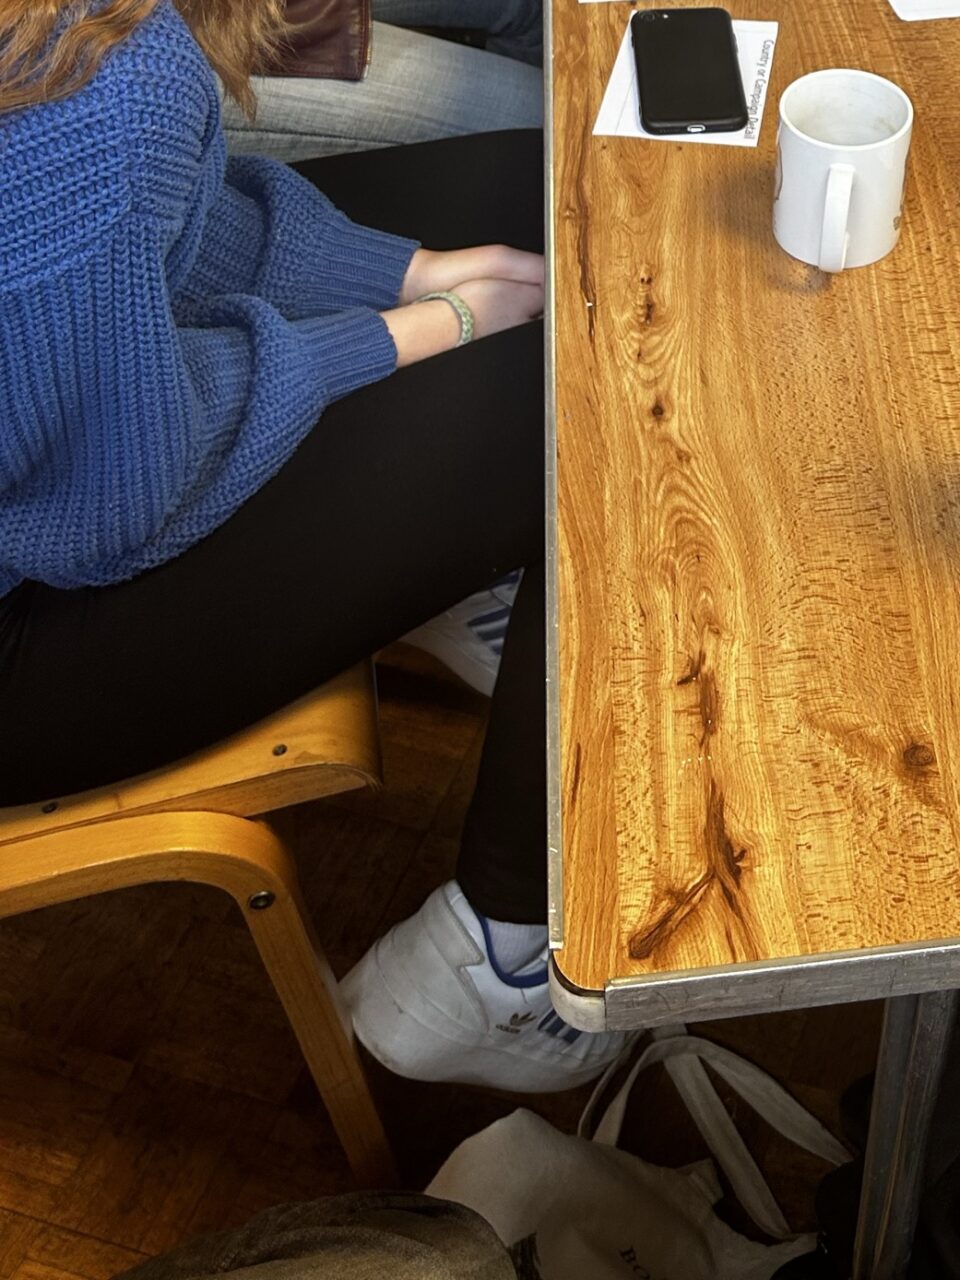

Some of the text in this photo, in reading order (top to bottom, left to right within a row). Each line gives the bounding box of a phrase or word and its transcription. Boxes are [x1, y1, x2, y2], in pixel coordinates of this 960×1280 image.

[743, 39, 775, 140] Country or Campaign Detail
